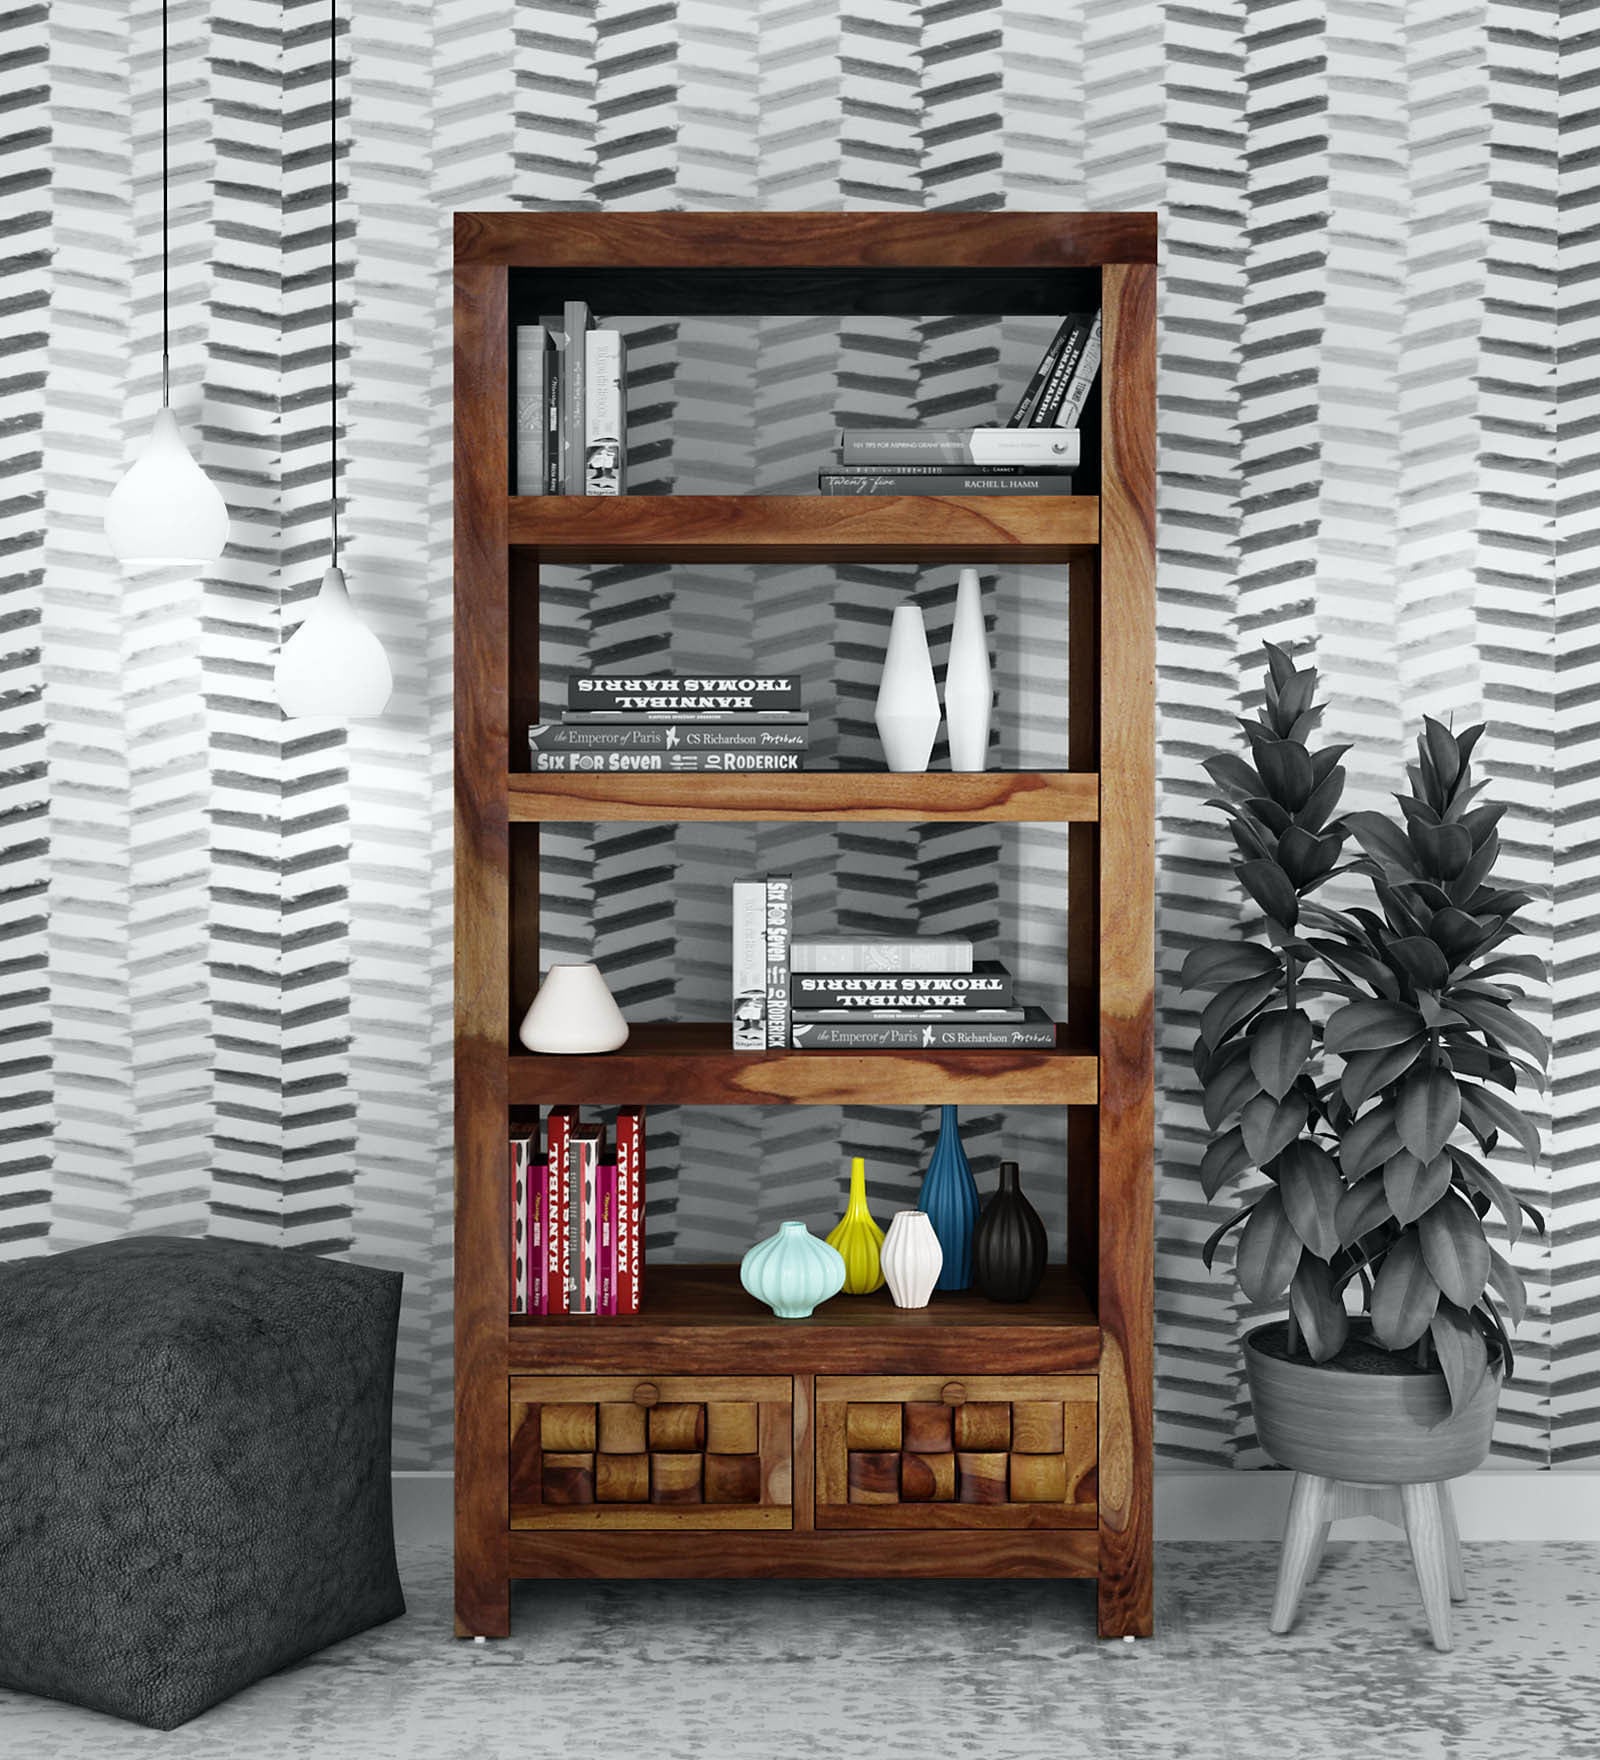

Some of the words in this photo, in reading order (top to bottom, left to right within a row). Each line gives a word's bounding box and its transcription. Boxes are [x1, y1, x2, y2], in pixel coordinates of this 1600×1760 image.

[1055, 329, 1080, 378] THOMAS
[1049, 349, 1080, 410] HANNIBAL
[1035, 378, 1059, 423] HARRIS
[877, 441, 889, 449] FOR
[964, 480, 1000, 489] RACHEL
[1001, 480, 1008, 489] L.
[1009, 480, 1040, 489] HAMM
[578, 679, 682, 692] HARRIS
[684, 679, 792, 692] THOMAS
[615, 697, 753, 708] HANNIBAL
[553, 730, 568, 742] the
[569, 731, 620, 747] Emperor
[619, 730, 633, 747] of
[632, 731, 662, 744] Paris
[686, 732, 701, 745] CS
[703, 731, 756, 745] Richardson
[609, 753, 662, 771] Seven
[724, 753, 798, 770] RODERICK
[801, 978, 898, 991] HARRIS
[901, 978, 1003, 991] THOMAS
[836, 995, 967, 1007] HANNIBAL
[767, 1000, 787, 1048] RODERICK
[816, 1030, 830, 1042] the
[831, 1031, 880, 1046] Emperor
[879, 1030, 891, 1046] of
[891, 1031, 918, 1043] Paris
[942, 1032, 955, 1044] CS
[957, 1031, 1008, 1044] Richardson
[549, 1142, 559, 1273] HANNIBAL
[618, 1142, 628, 1273] HANNIBAL
